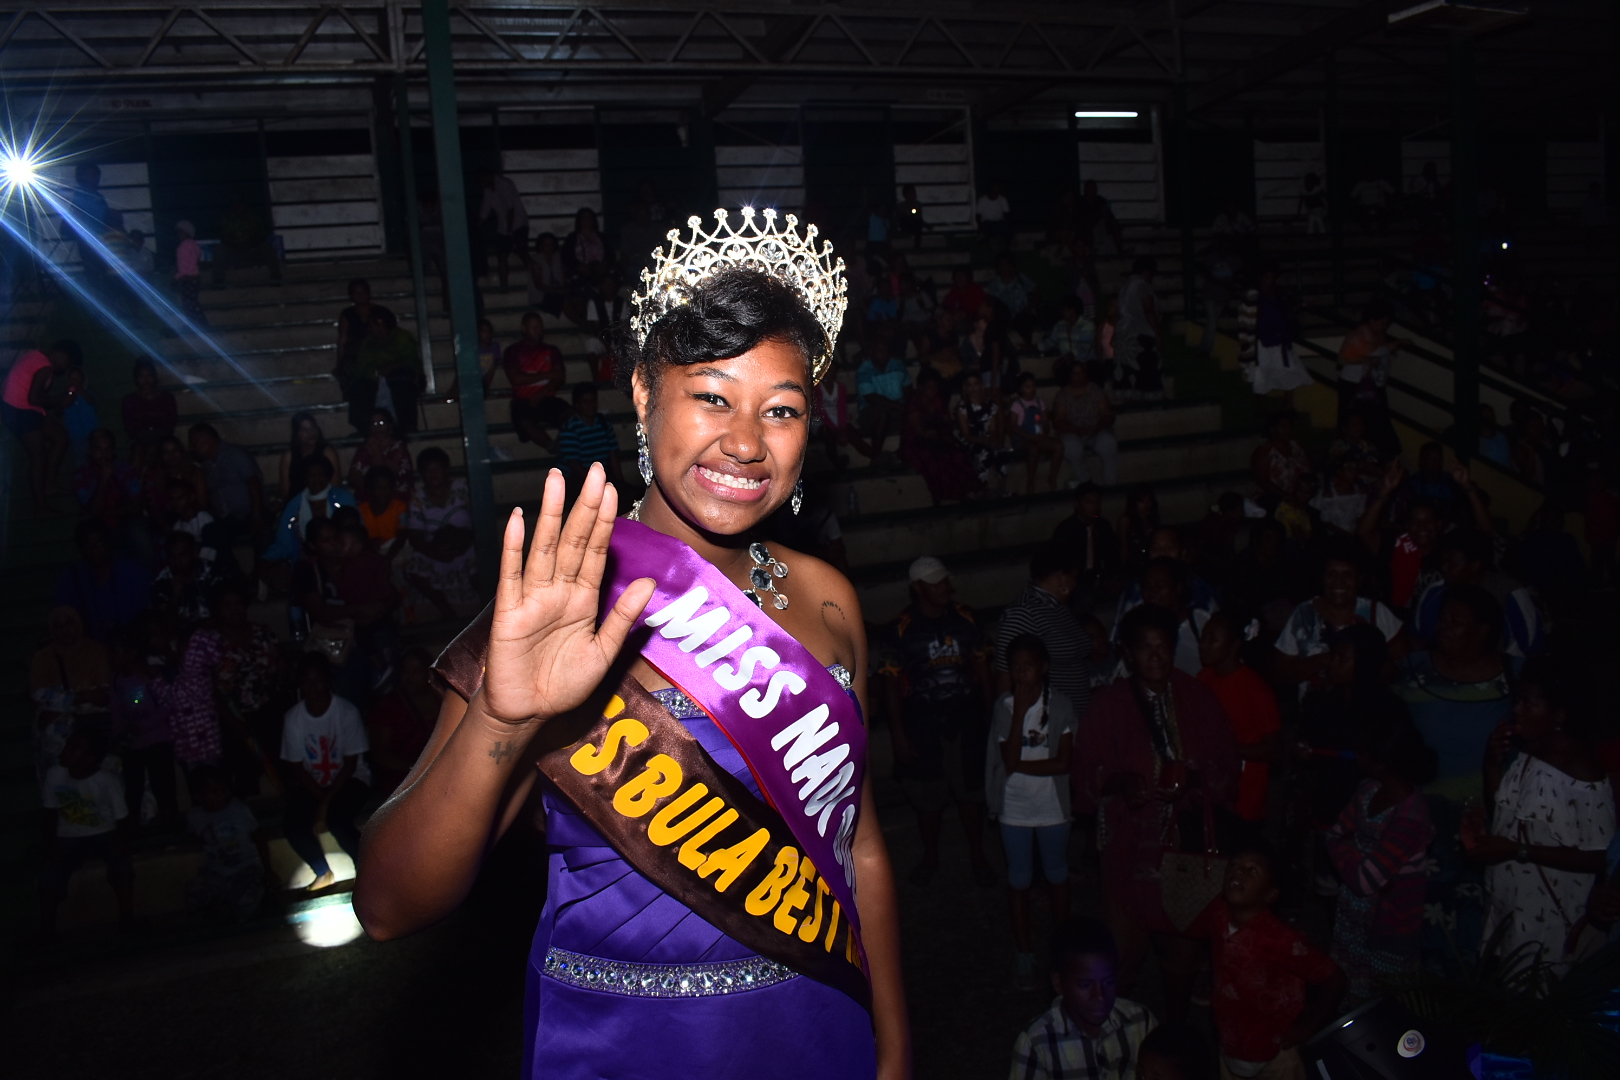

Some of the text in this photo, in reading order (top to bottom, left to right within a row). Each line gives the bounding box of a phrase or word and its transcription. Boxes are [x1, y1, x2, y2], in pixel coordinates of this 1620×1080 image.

[644, 585, 806, 719] MISS
[562, 694, 650, 776] S
[612, 753, 770, 893] BULA
[744, 845, 841, 954] BEST
